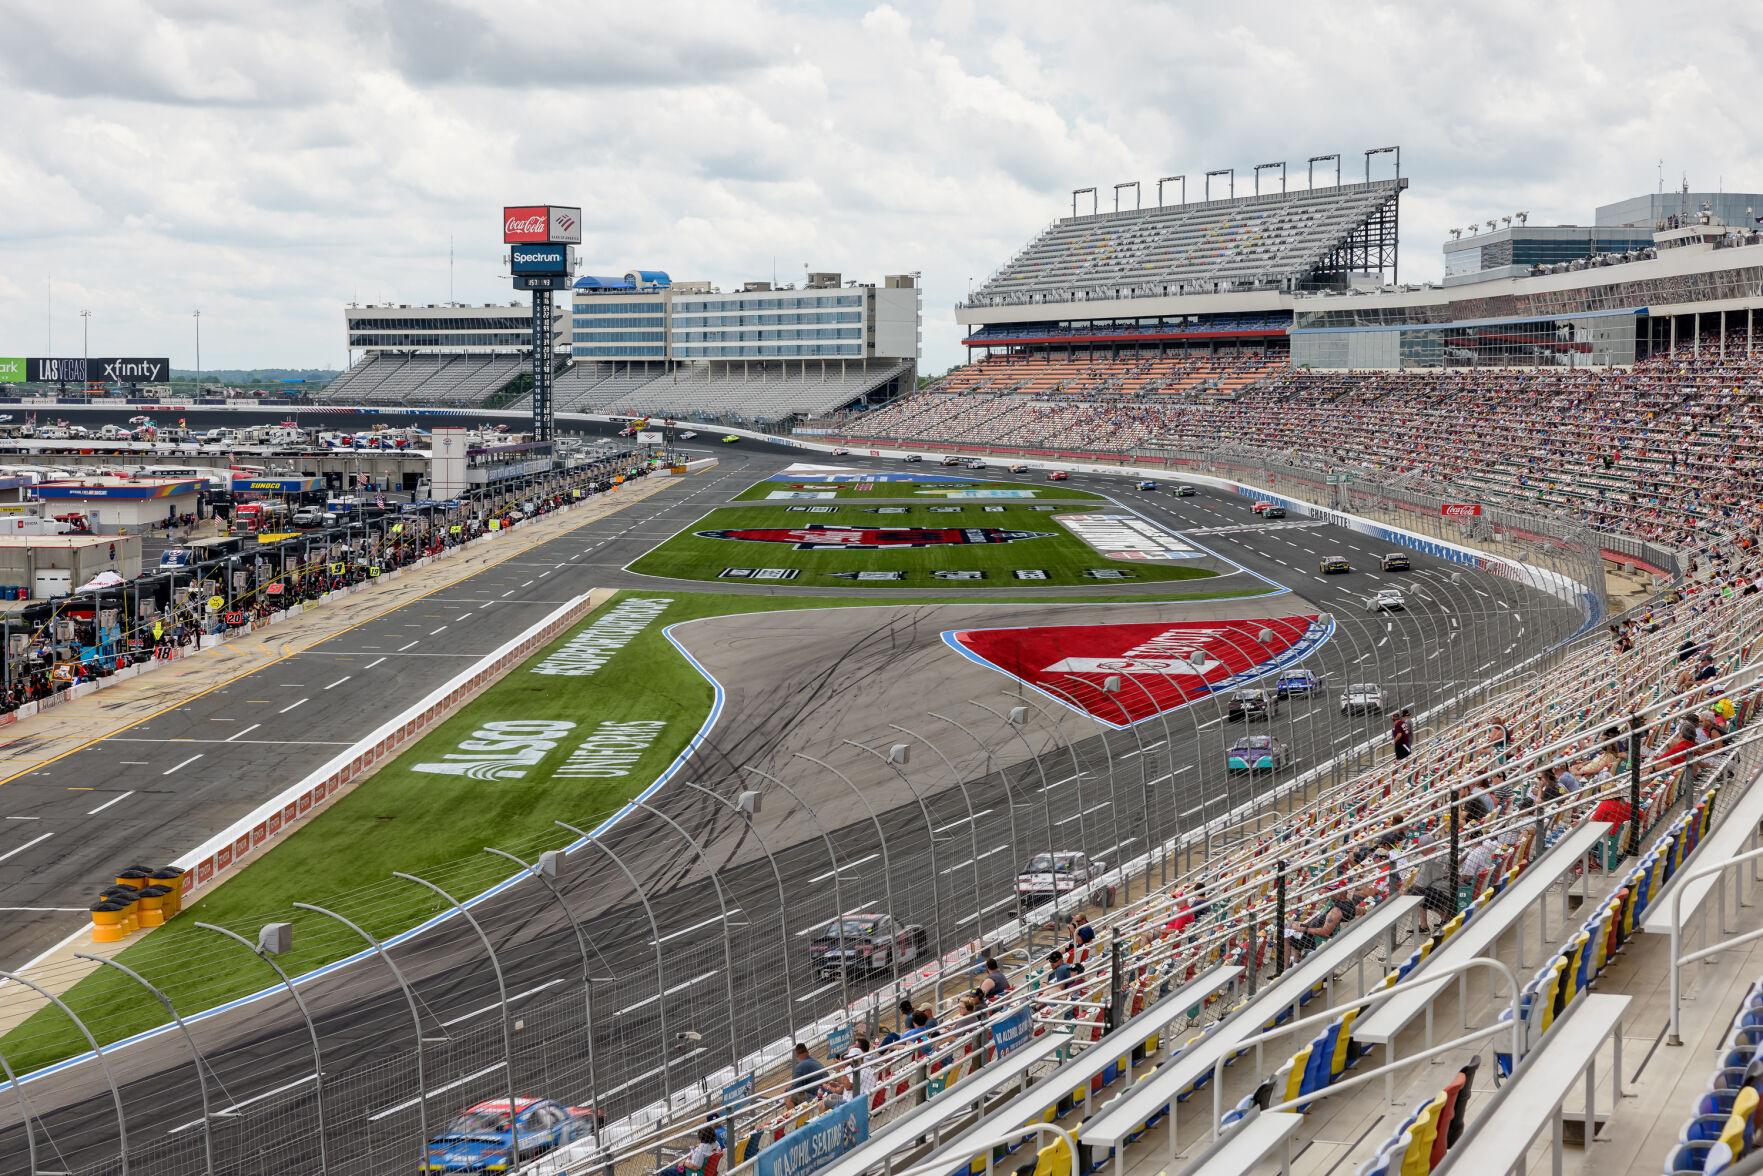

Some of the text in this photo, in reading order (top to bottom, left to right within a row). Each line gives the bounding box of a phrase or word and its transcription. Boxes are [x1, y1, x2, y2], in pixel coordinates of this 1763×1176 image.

[514, 253, 560, 263] Spectrum
[104, 359, 160, 380] xfinity
[1310, 508, 1348, 528] CHARLOTTE
[228, 613, 240, 623] 20
[1121, 628, 1230, 658] TOYOTA
[157, 647, 170, 660] 18
[410, 720, 576, 781] ALSCO
[552, 720, 667, 778] UNIFORMS
